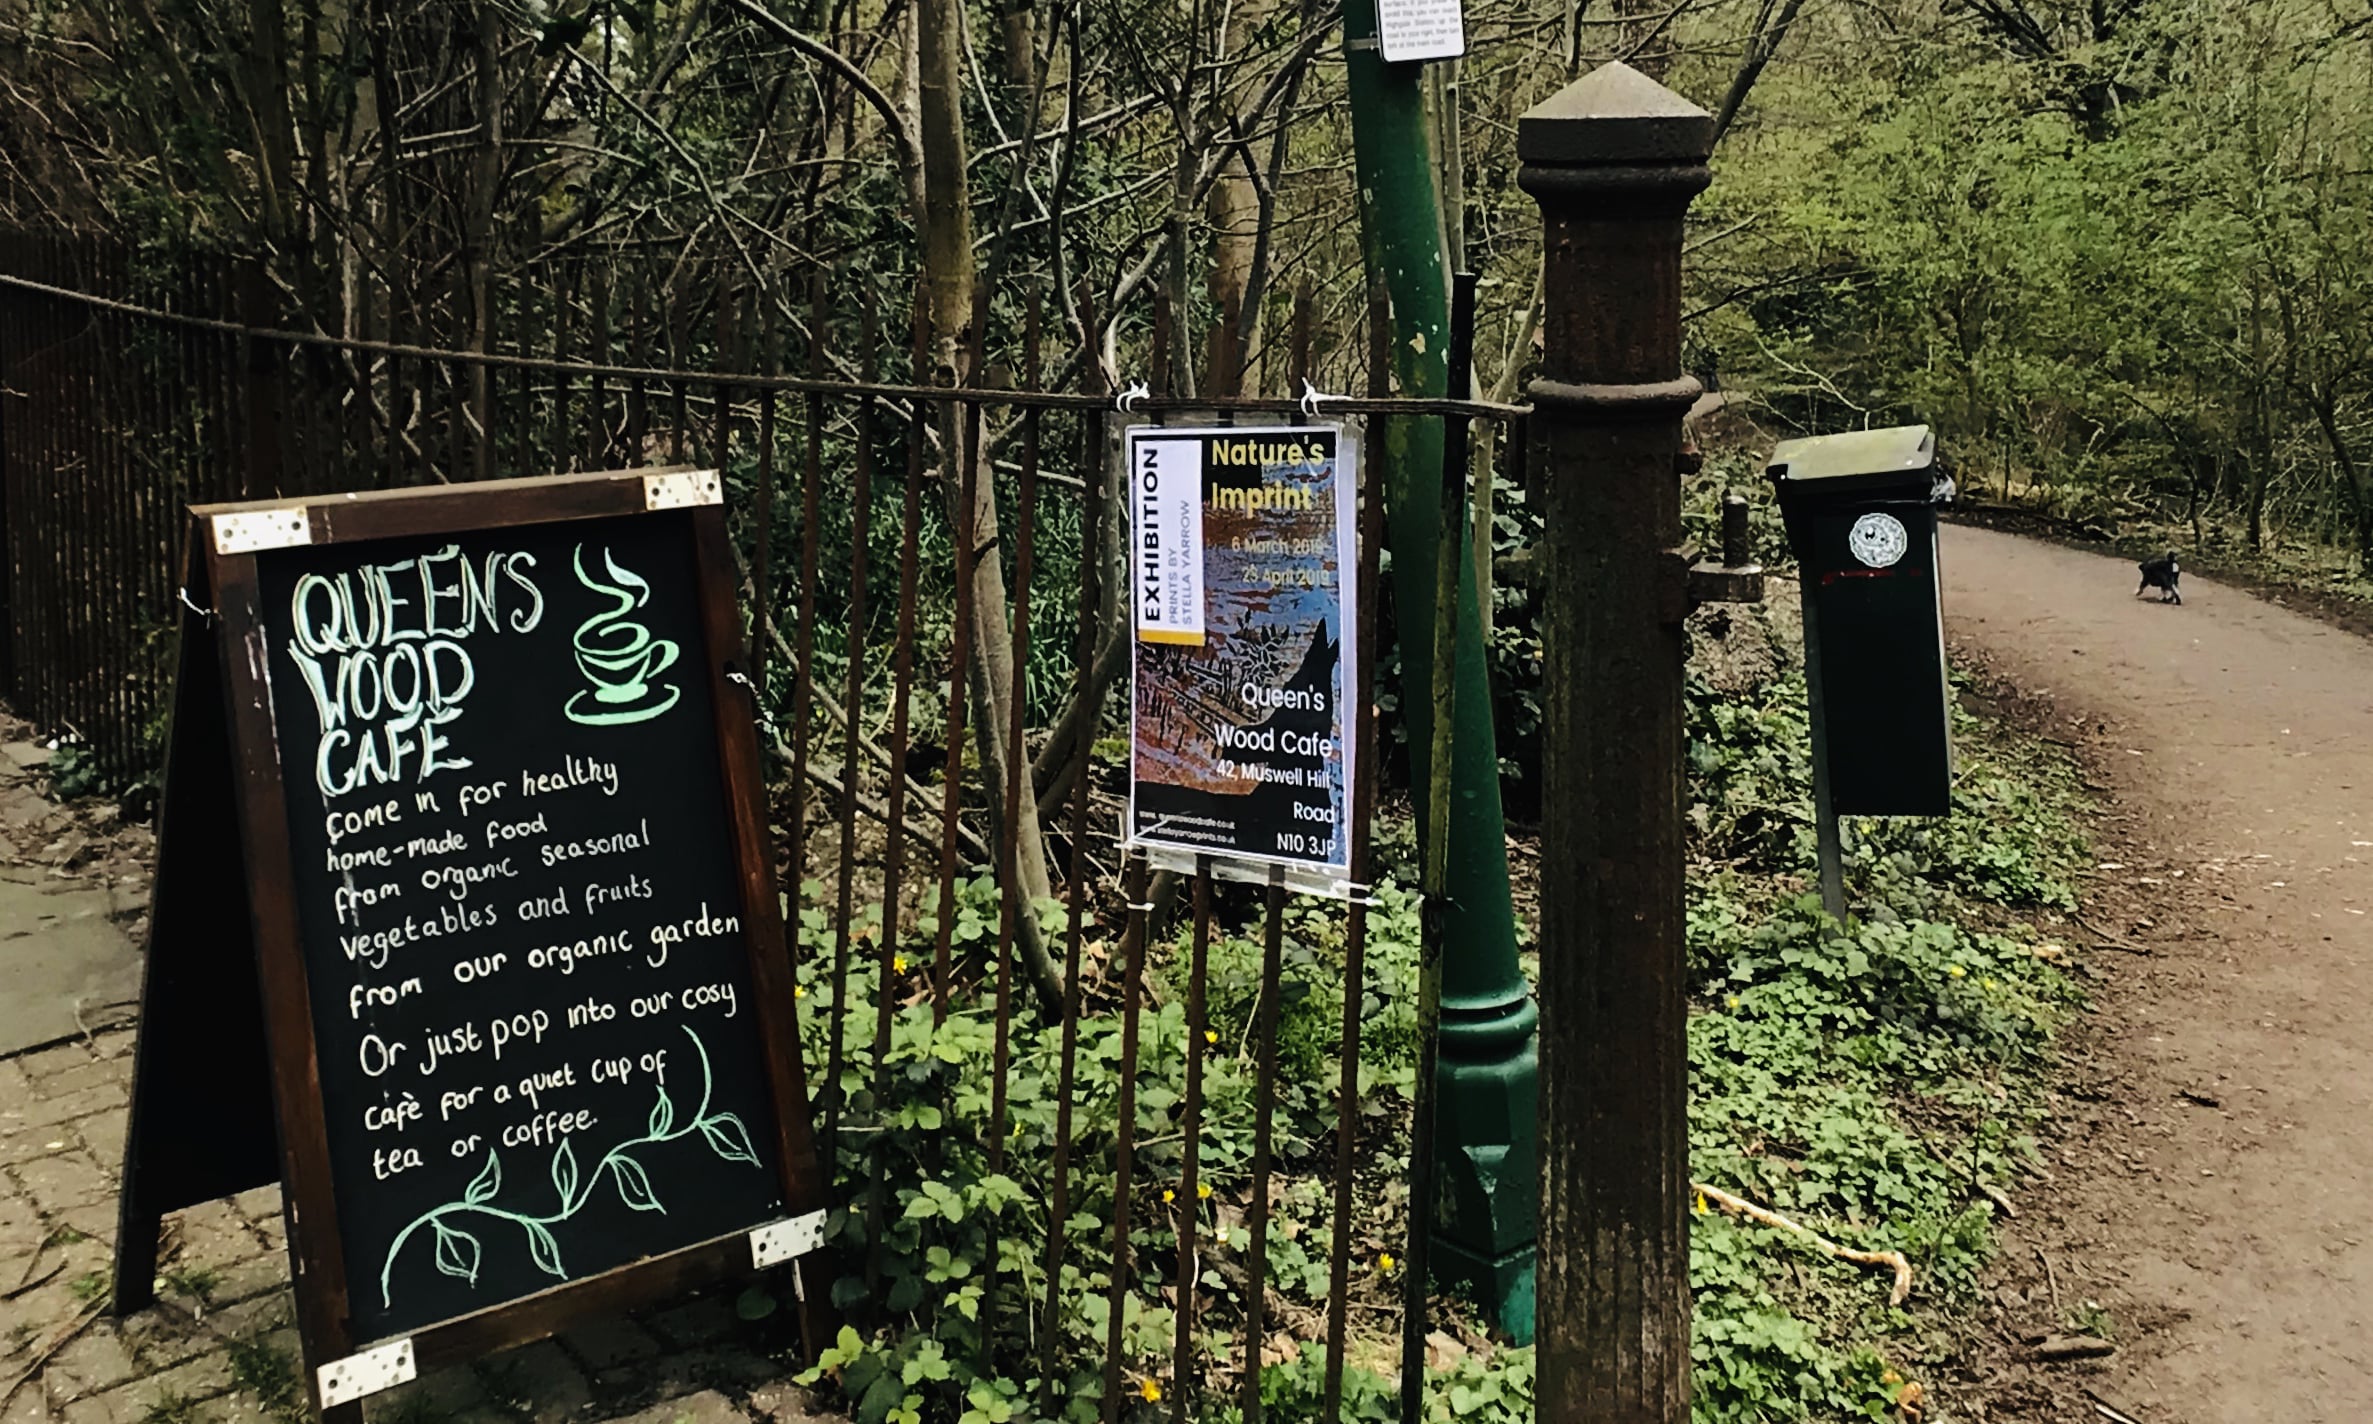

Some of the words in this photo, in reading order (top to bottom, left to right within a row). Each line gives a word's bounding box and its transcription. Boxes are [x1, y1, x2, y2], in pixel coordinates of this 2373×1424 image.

[1212, 435, 1325, 466] Nature's
[1212, 481, 1312, 519] Imprint
[1144, 449, 1160, 621] EXHIBITION
[1169, 548, 1177, 566] BY
[1181, 500, 1191, 570] YARROW
[1231, 536, 1239, 553] 6
[1245, 538, 1289, 555] March
[292, 543, 544, 656] QUEENS
[1169, 573, 1178, 624] PRINTS
[1182, 573, 1192, 625] STELLA
[1262, 567, 1293, 586] April
[1294, 568, 1330, 586] 2019
[288, 638, 475, 734] WOOD
[1241, 682, 1325, 712] Queen's
[317, 706, 473, 797] CAFE
[1214, 724, 1274, 752] Wood
[1281, 730, 1332, 757] Cafe
[416, 793, 440, 813] in
[459, 783, 506, 817] for
[521, 754, 620, 796] healthy
[1217, 760, 1238, 781] 42,
[1241, 763, 1303, 786] Muswell
[1307, 769, 1330, 789] Hill
[1293, 802, 1335, 823] Road
[327, 830, 467, 872] home-made
[486, 813, 548, 848] food
[335, 883, 400, 925] from
[421, 859, 518, 900] organic
[541, 819, 649, 867] seasonal
[1277, 833, 1304, 853] N10
[1309, 837, 1336, 856] 3JP
[340, 903, 496, 969] vegetables
[518, 891, 570, 921] and
[585, 875, 653, 914] fruits
[350, 977, 422, 1019] from
[454, 952, 507, 983] our
[528, 929, 632, 974] organic
[648, 902, 739, 968] garden
[359, 1035, 407, 1077] Or
[419, 1021, 482, 1075] just
[491, 1009, 549, 1059] pop
[568, 997, 616, 1029] into
[630, 992, 673, 1017] our
[682, 982, 736, 1018] cosy
[441, 1089, 483, 1121] for
[495, 1084, 511, 1103] a
[519, 1064, 577, 1109] quiet
[640, 1050, 668, 1082] of
[373, 1148, 423, 1179] tea
[451, 1134, 482, 1158] or
[502, 1108, 598, 1148] coffee.
